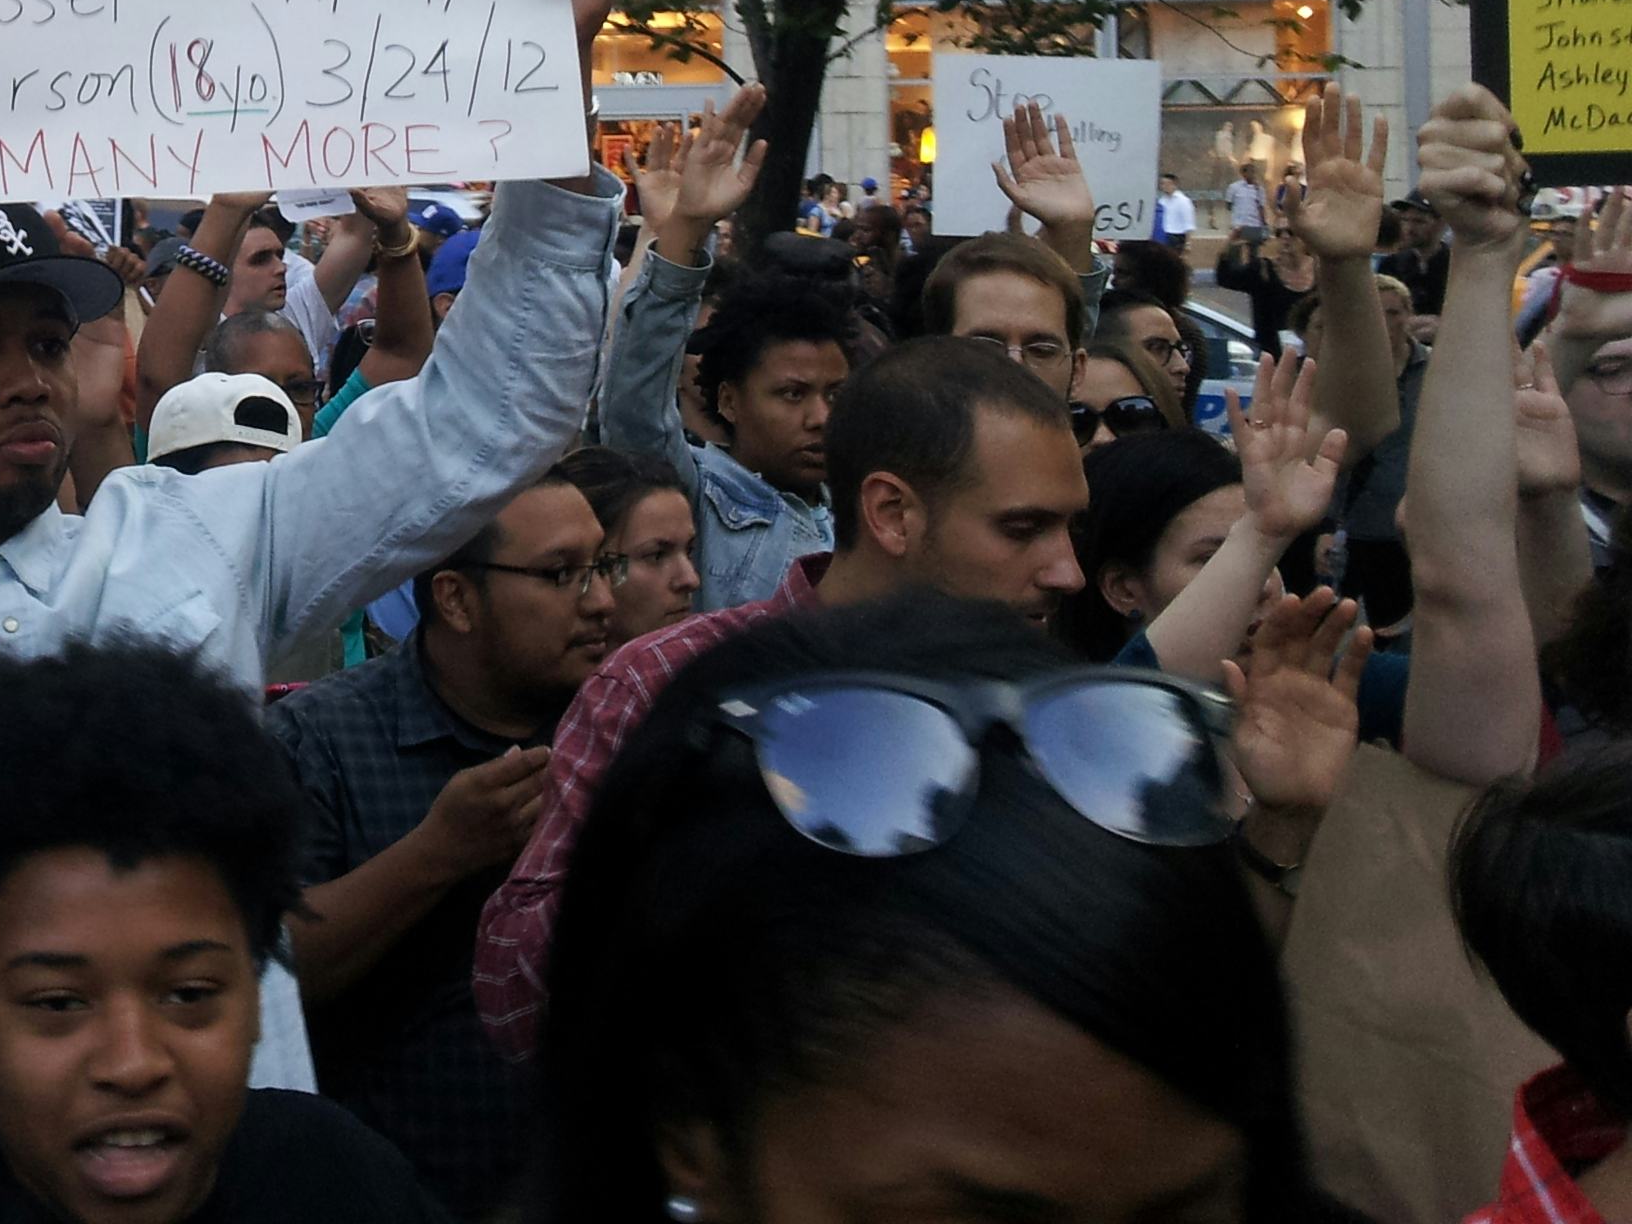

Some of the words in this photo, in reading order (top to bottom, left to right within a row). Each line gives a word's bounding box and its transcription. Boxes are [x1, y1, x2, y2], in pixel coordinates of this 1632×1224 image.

[306, 1, 558, 122] 3/24/12
[1537, 60, 1628, 96] Ashley
[1046, 114, 1122, 153] lling
